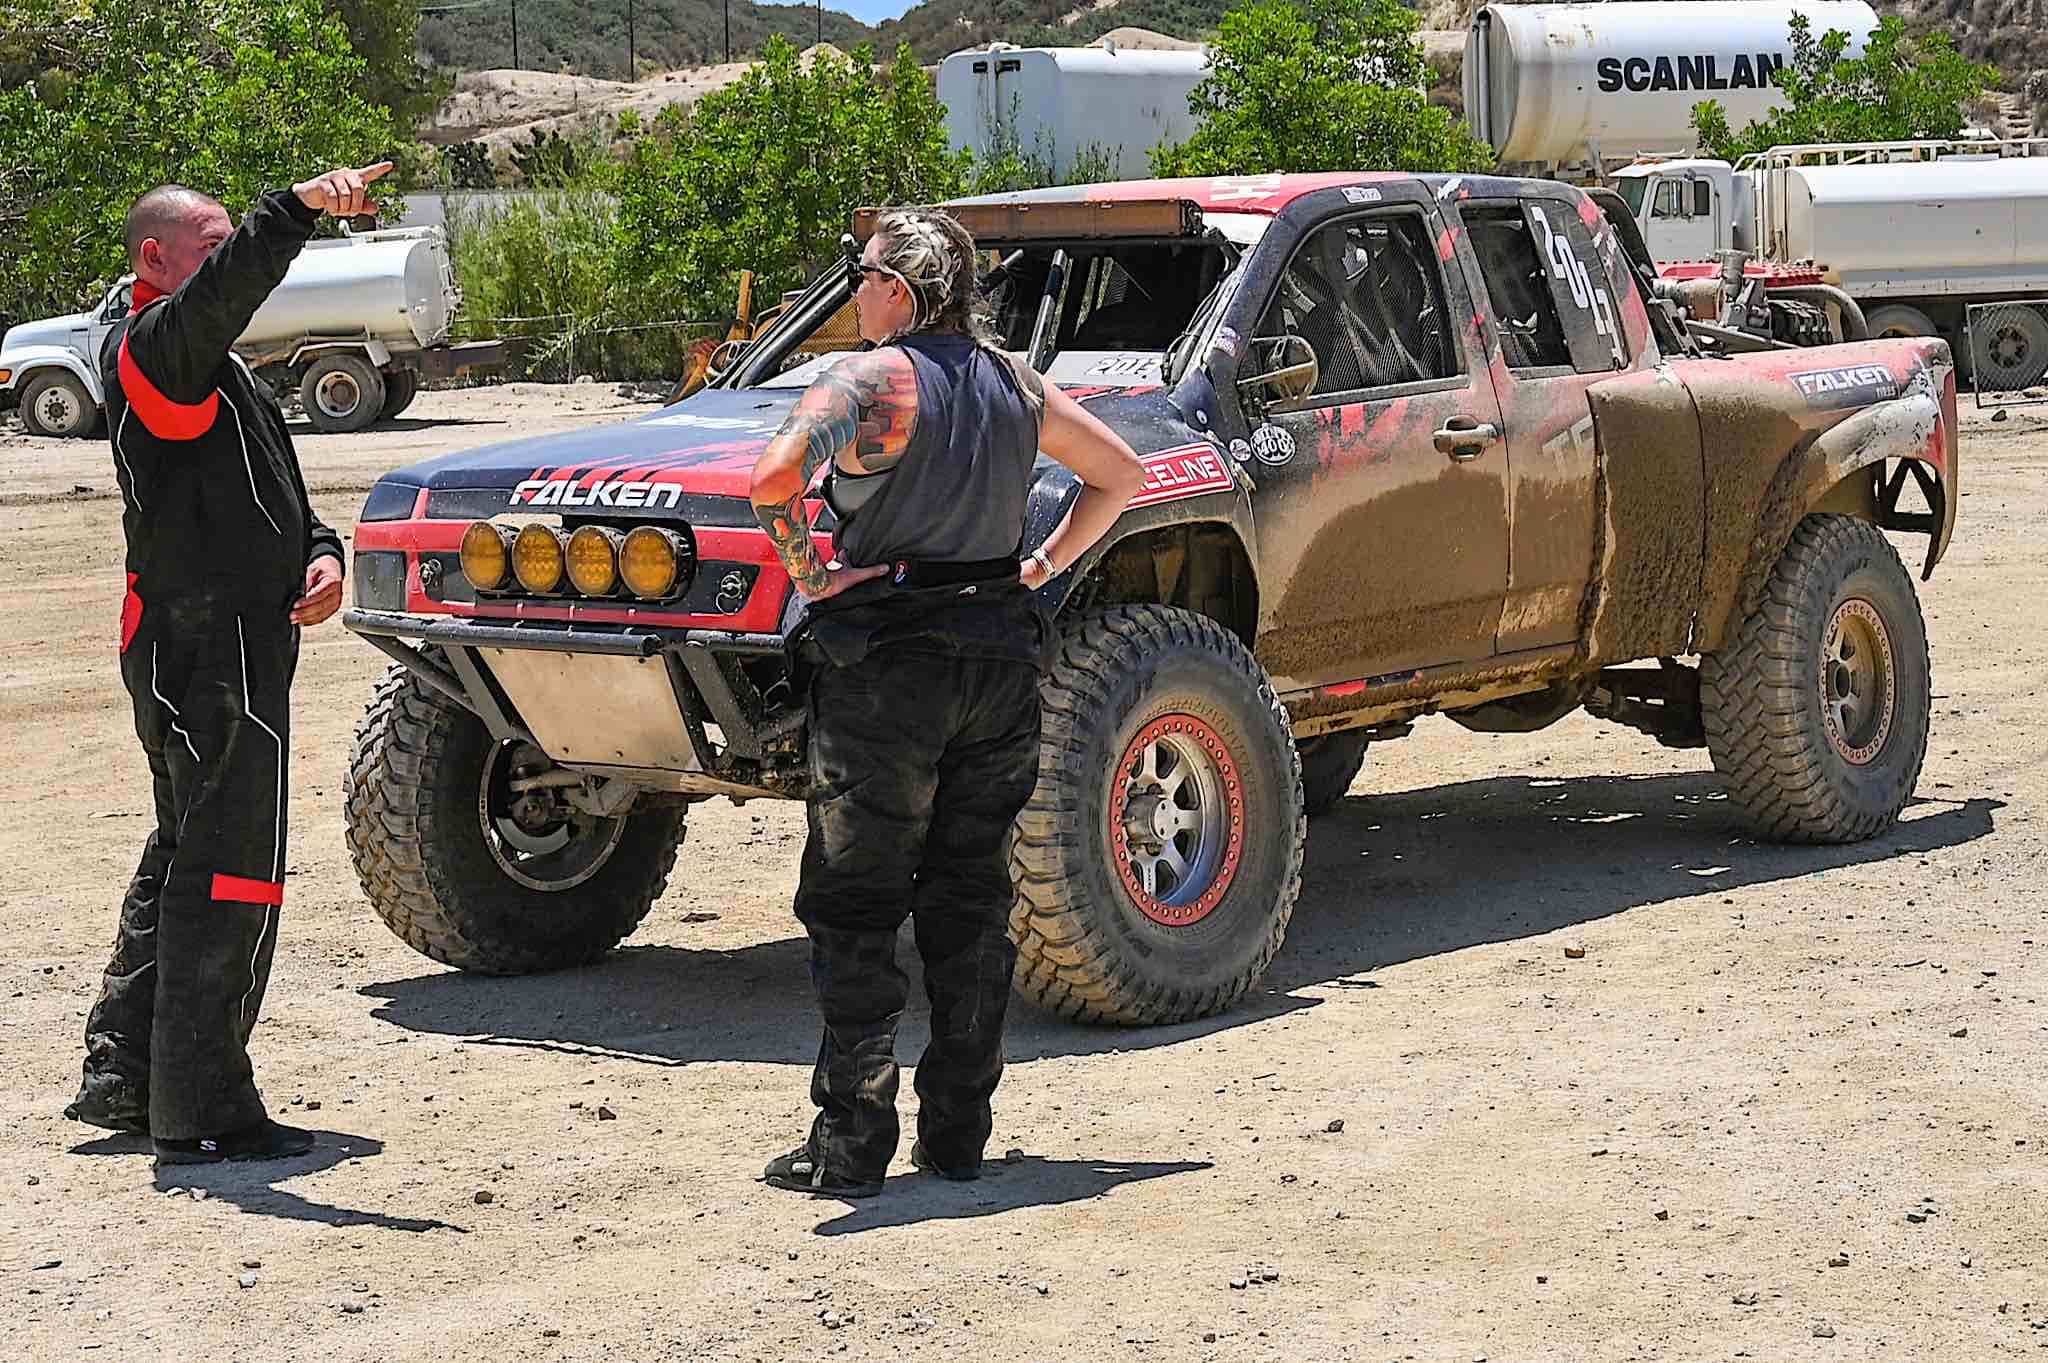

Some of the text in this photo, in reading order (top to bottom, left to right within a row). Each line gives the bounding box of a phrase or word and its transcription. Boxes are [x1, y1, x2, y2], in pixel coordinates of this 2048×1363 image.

[1597, 53, 1785, 92] SCANLAN
[1797, 366, 1892, 395] FALKEN
[509, 479, 683, 508] FALKEN
